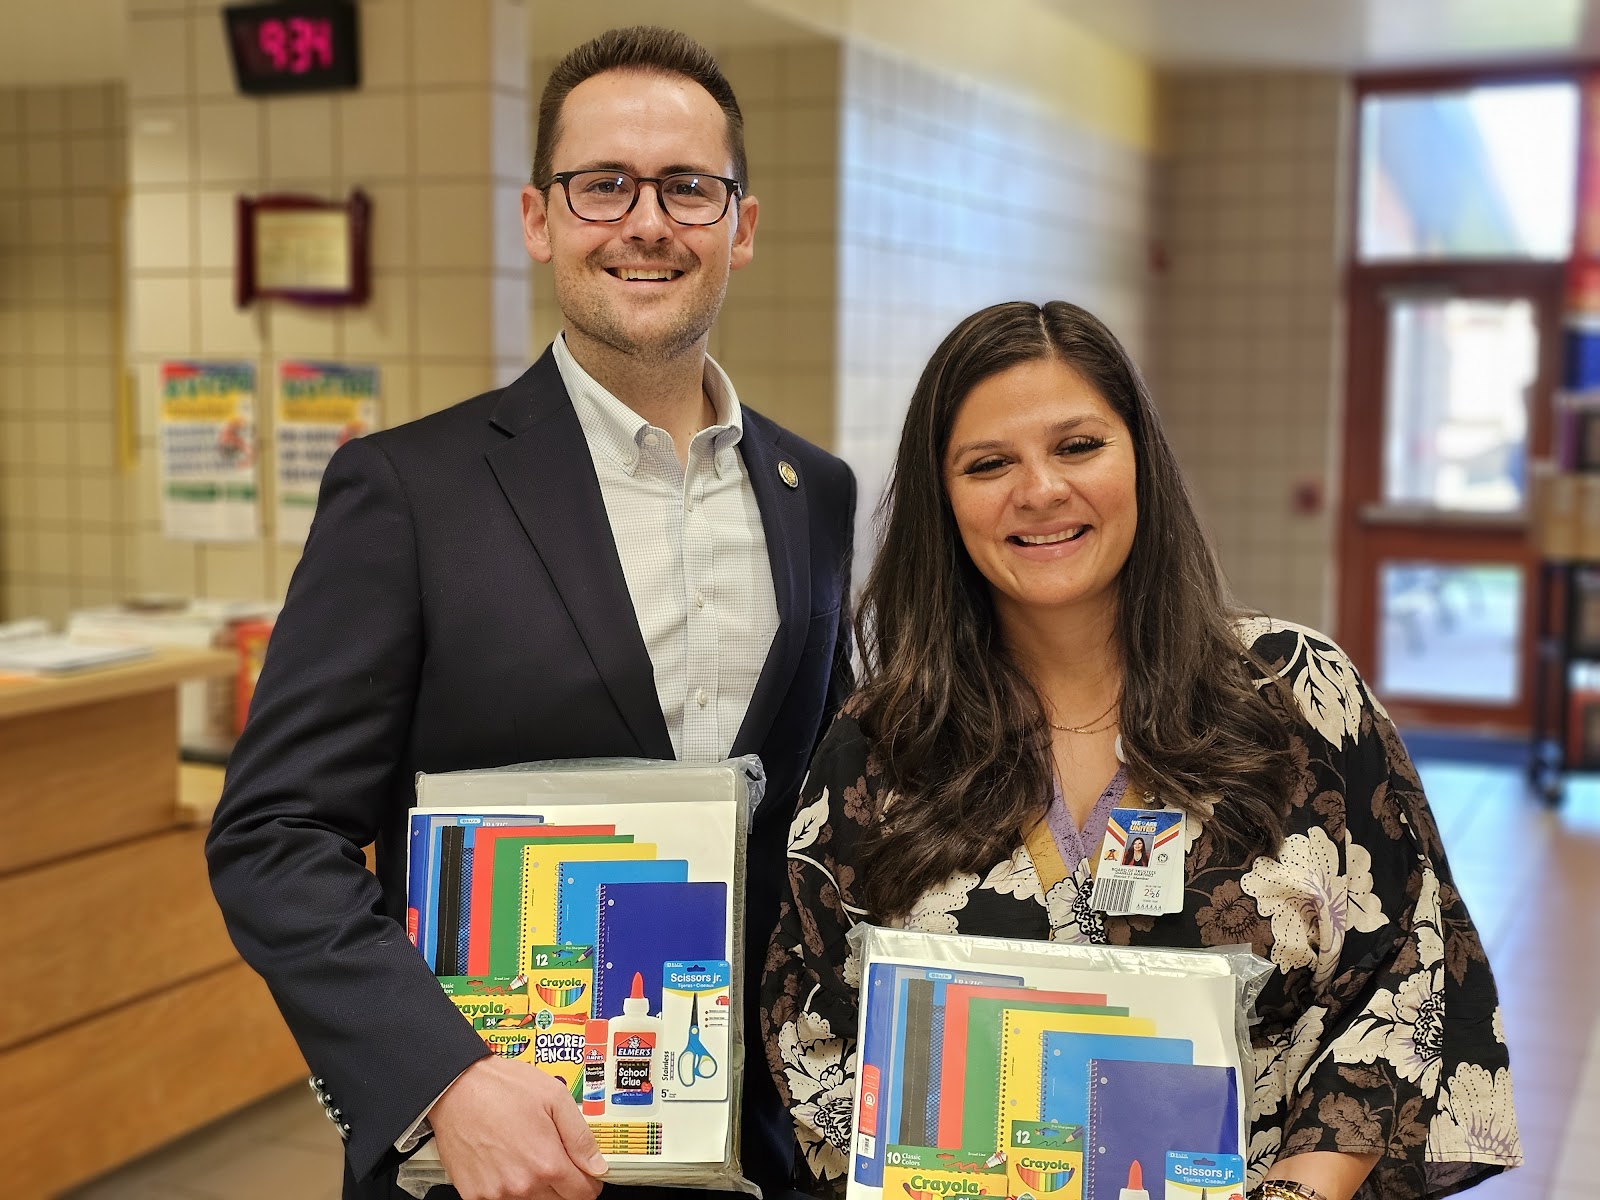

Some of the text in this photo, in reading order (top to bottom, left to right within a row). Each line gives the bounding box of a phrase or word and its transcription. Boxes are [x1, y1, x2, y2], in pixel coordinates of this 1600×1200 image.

[1130, 825, 1157, 833] UNITED
[535, 953, 549, 967] 12
[539, 977, 582, 988] Crayola
[670, 973, 722, 985] Scissors jr.
[458, 1002, 504, 1016] rayola
[485, 1017, 496, 1027] 24
[488, 1034, 527, 1044] Crayola
[536, 1034, 586, 1048] OLORED
[617, 1048, 652, 1056] ELMER'S
[618, 1067, 648, 1077] School
[621, 1077, 641, 1087] Glue
[1015, 1129, 1030, 1144] 12
[886, 1151, 922, 1164] 10 Classic
[901, 1159, 921, 1167] Colors
[1020, 1157, 1070, 1171] Crayola
[1174, 1164, 1235, 1180] Scissors jr.
[910, 1175, 980, 1195] Crayola
